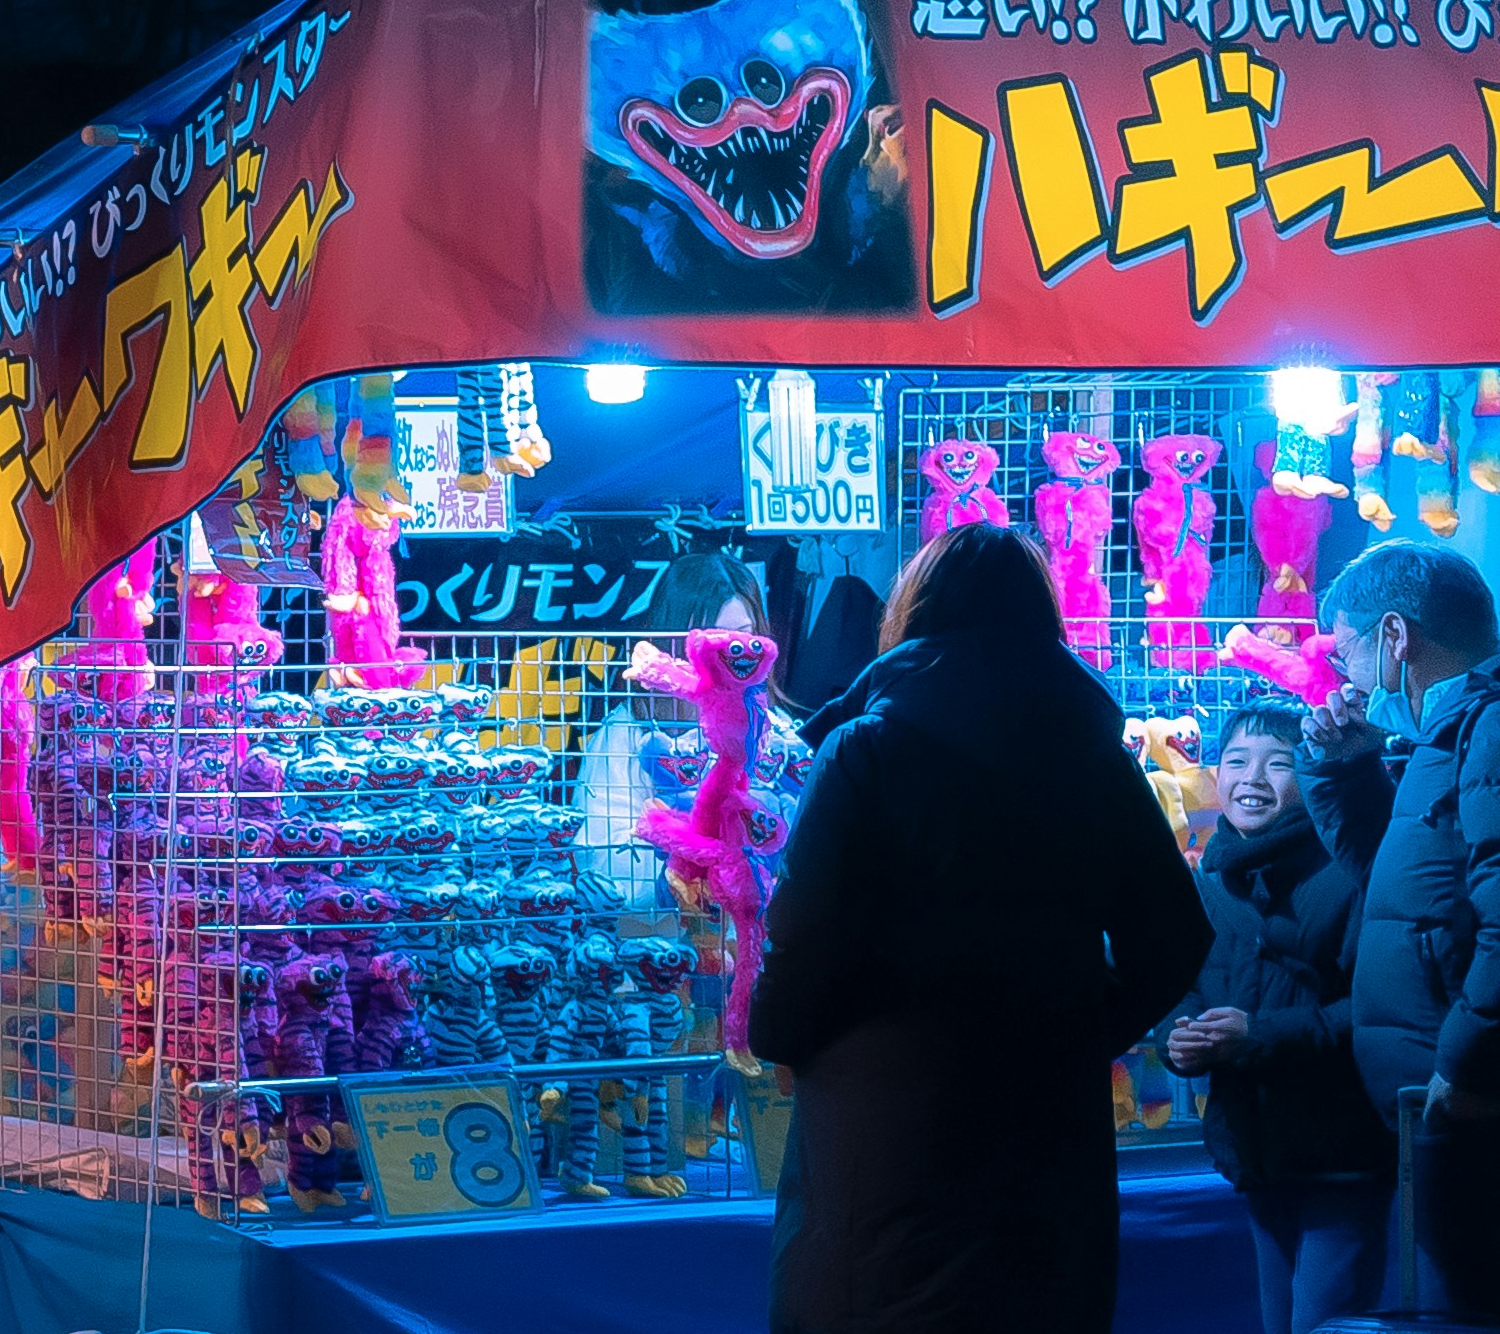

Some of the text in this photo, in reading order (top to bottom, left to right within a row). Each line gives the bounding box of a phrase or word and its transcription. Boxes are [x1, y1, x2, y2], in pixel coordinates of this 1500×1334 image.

[90, 7, 353, 260] びっくりモンスター
[924, 44, 1500, 326] ハギー
[752, 420, 872, 474] くびき
[751, 479, 875, 524] 1回500円
[443, 1102, 526, 1208] 8
